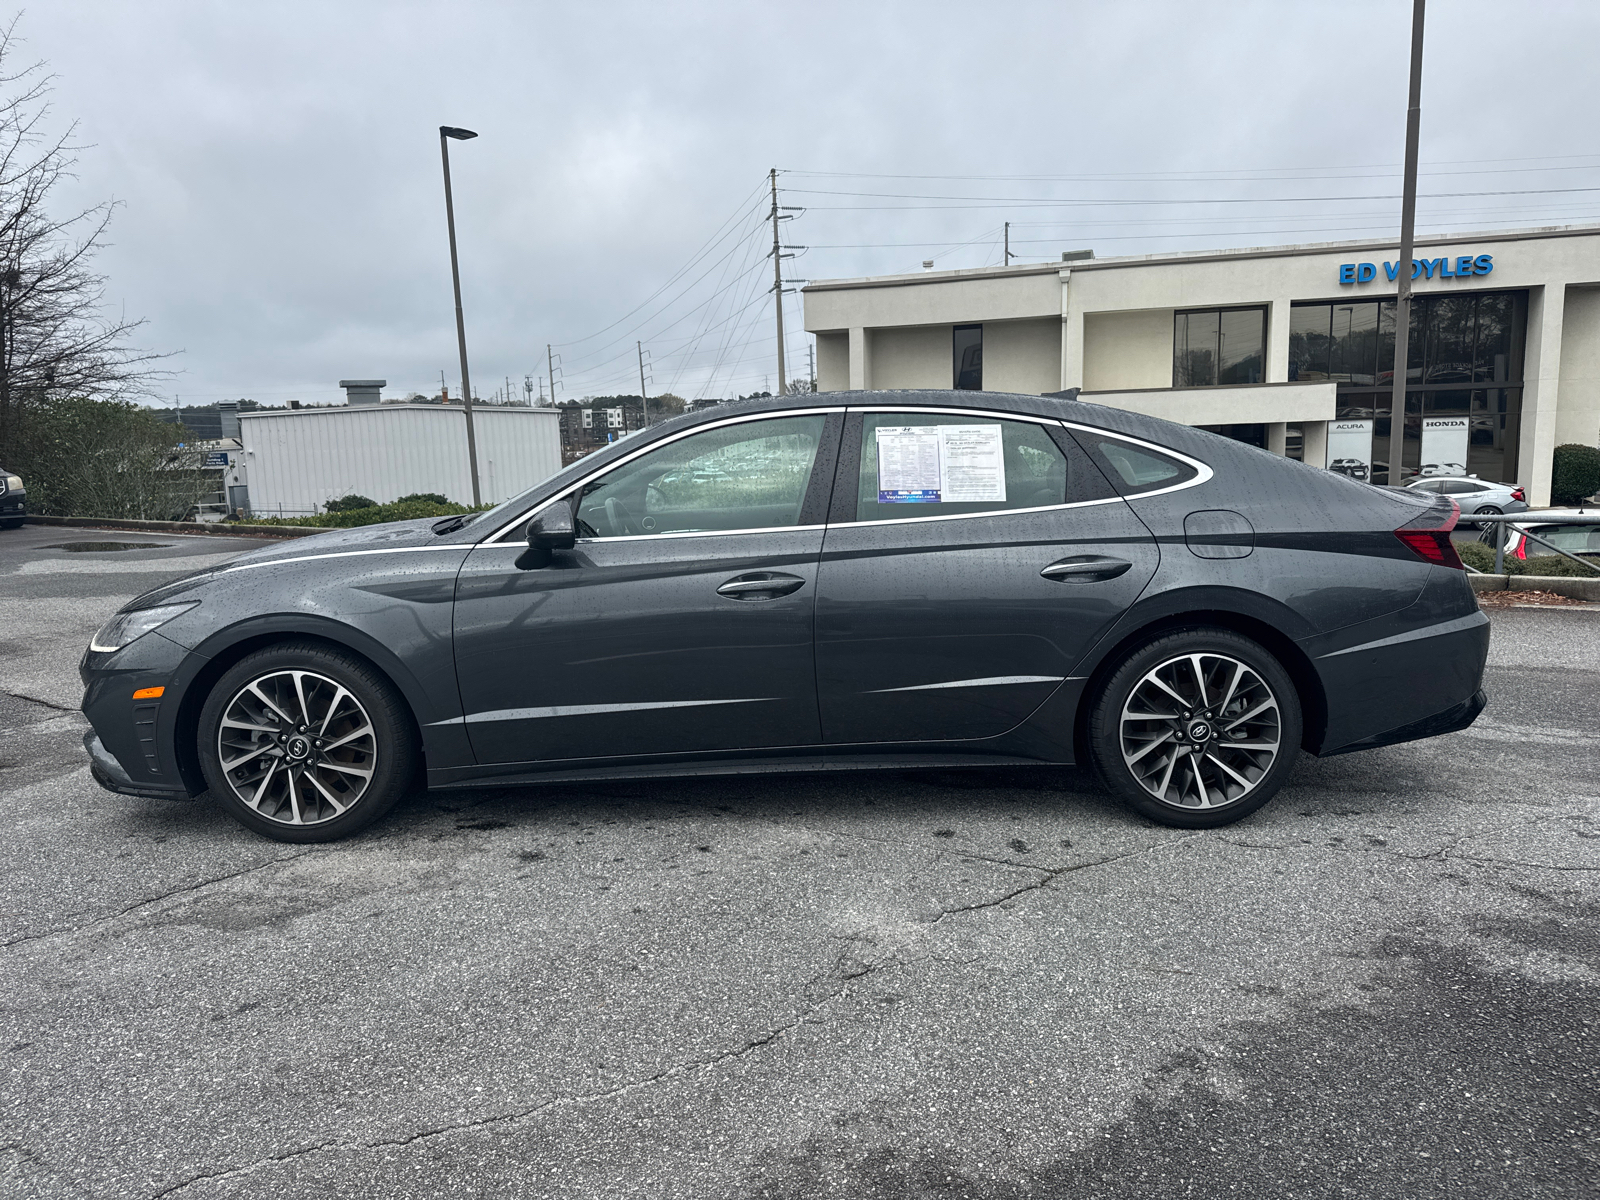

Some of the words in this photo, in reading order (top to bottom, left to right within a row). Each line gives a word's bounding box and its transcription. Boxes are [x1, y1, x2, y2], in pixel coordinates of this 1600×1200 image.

[1339, 262, 1377, 284] ED
[1383, 254, 1494, 282] VOYLES
[1425, 420, 1466, 428] HONDA
